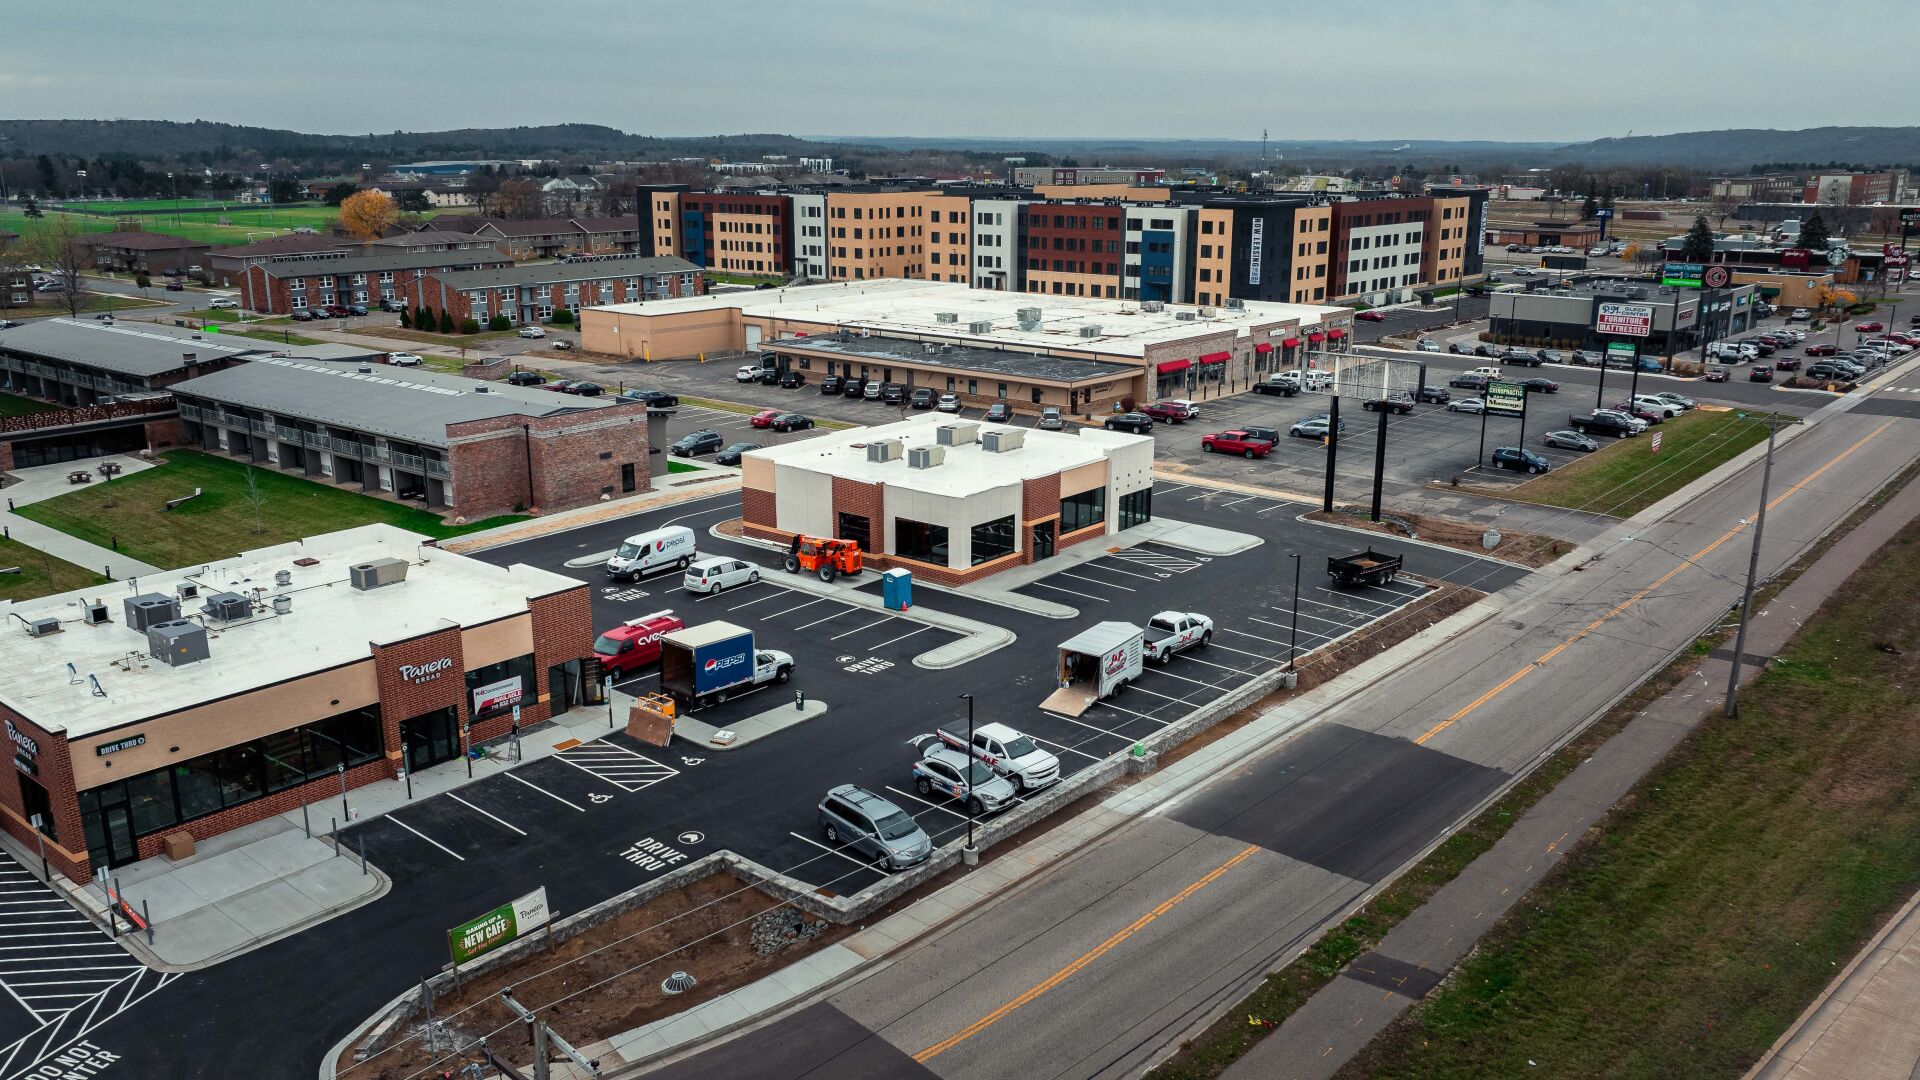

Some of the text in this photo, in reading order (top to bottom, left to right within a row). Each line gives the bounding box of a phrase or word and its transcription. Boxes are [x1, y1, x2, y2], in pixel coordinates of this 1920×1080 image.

[1254, 218, 1262, 235] NOW
[1252, 237, 1261, 267] LEASING
[1884, 256, 1907, 264] Wendy's
[1604, 315, 1644, 325] FURNITURE
[1599, 323, 1647, 335] MATTRESSES
[1489, 387, 1524, 397] CHIROPRACTIC
[1488, 399, 1522, 409] Massage
[666, 535, 685, 550] pepsi
[399, 657, 452, 681] Panera
[714, 652, 746, 671] PEPSI
[843, 656, 884, 673] DRIVE
[859, 661, 895, 675] THRU
[415, 672, 441, 684] BREAD
[493, 690, 522, 704] AVAILABLE
[5, 719, 38, 756] Panera
[100, 739, 137, 755] DRIVE THRU
[619, 846, 666, 871] THRU
[634, 837, 688, 864] DRIVE
[519, 902, 544, 919] Panera
[463, 919, 507, 949] NEW CAFE
[465, 921, 489, 936] BAKING
[488, 916, 497, 924] UP
[54, 1039, 101, 1068] NOT
[56, 1050, 122, 1080] NTER
